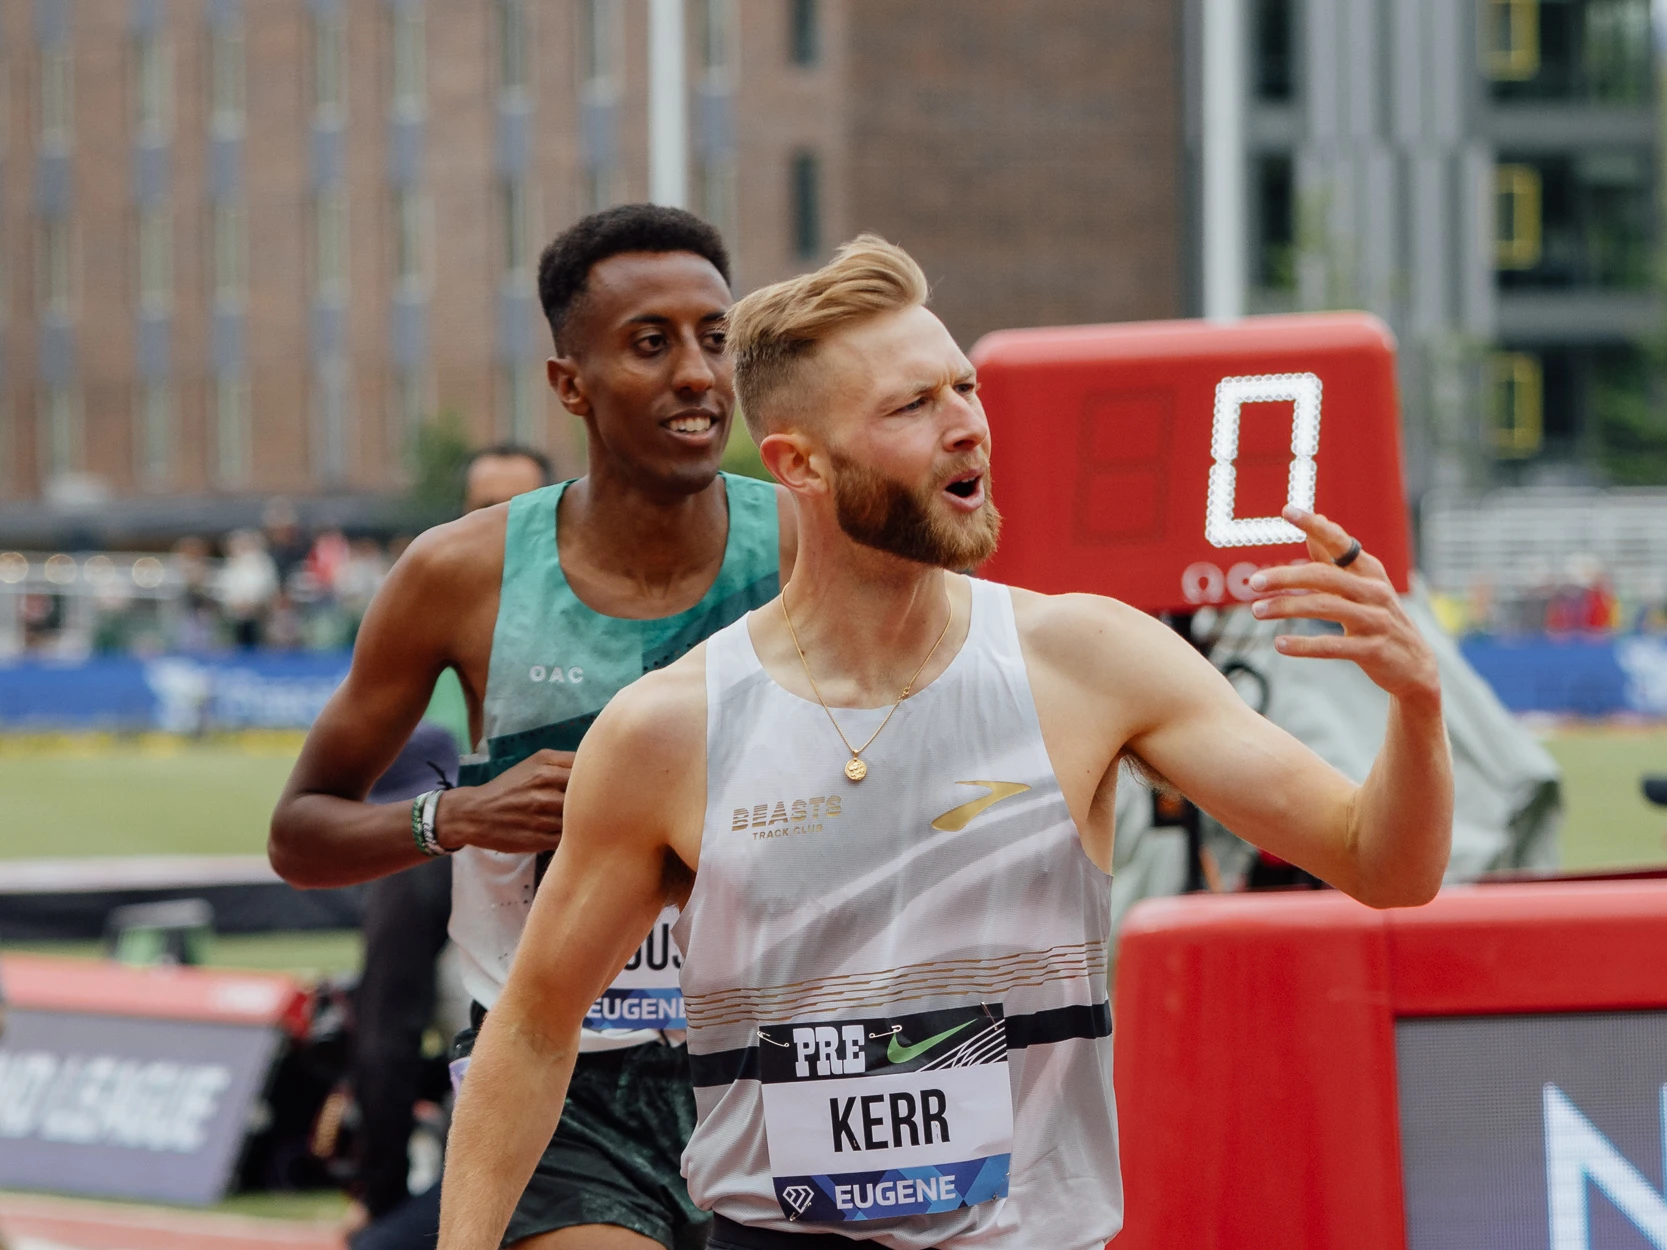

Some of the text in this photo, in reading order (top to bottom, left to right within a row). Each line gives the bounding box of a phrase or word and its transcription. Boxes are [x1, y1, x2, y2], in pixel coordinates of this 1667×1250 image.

[1205, 372, 1323, 548] 0
[529, 664, 584, 684] OAC
[731, 795, 842, 831] BEASTS
[753, 823, 823, 840] TRACK CLUB
[793, 1025, 866, 1077] PRE
[829, 1088, 951, 1153] KERR
[834, 1174, 956, 1210] EUGENE
